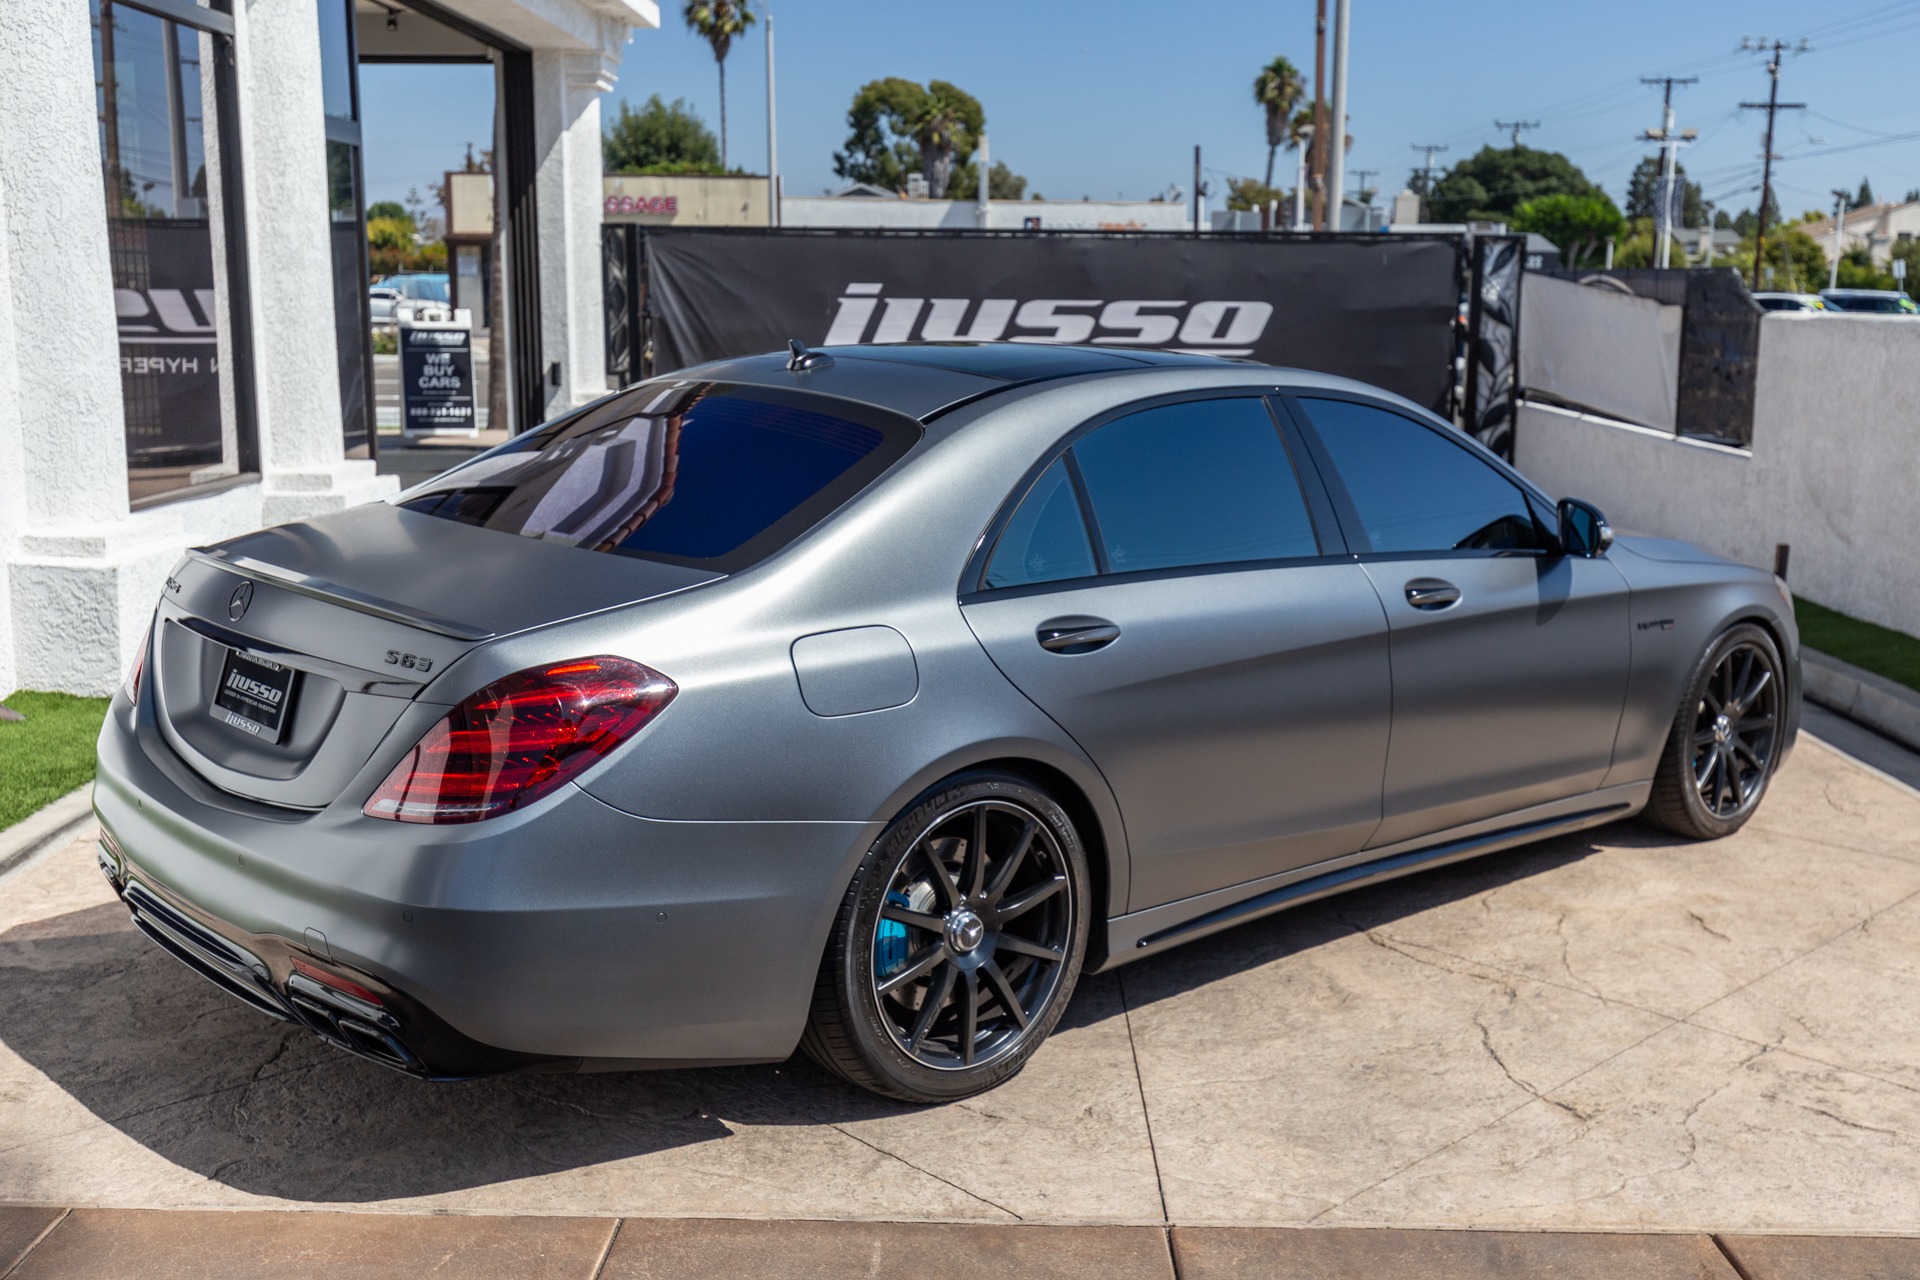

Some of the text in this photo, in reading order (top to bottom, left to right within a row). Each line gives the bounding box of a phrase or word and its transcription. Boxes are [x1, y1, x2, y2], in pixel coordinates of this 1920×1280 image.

[425, 353, 451, 364] WE
[423, 365, 455, 376] BUY
[418, 376, 461, 389] CARS
[384, 649, 433, 672] S63
